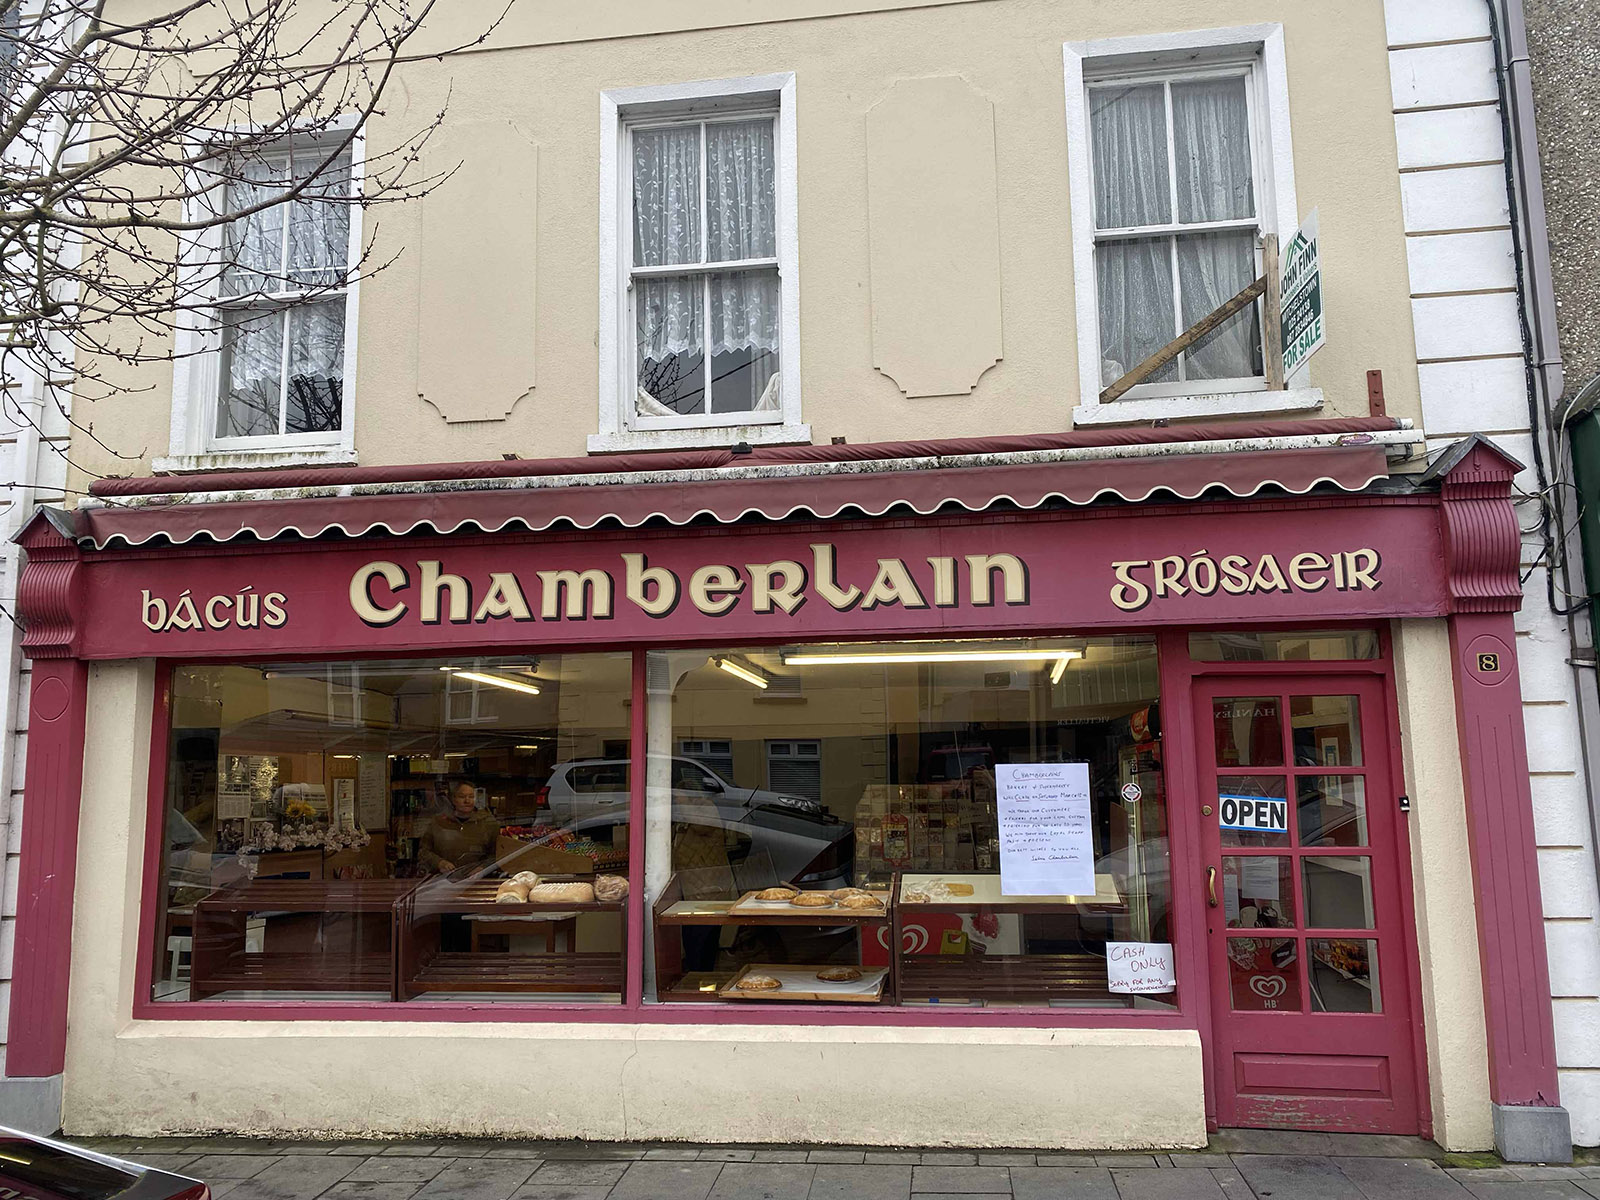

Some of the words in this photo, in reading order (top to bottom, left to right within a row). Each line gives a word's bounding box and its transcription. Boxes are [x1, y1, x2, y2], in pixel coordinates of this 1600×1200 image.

[1280, 263, 1297, 300] JOHN
[1298, 238, 1317, 275] FINN
[1282, 343, 1298, 374] FOR
[1299, 318, 1322, 356] SALE
[1482, 656, 1496, 671] 8
[1221, 798, 1286, 829] OPEN
[1110, 946, 1146, 962] CASH
[1130, 957, 1167, 973] ONLY
[1263, 999, 1278, 1009] HB
